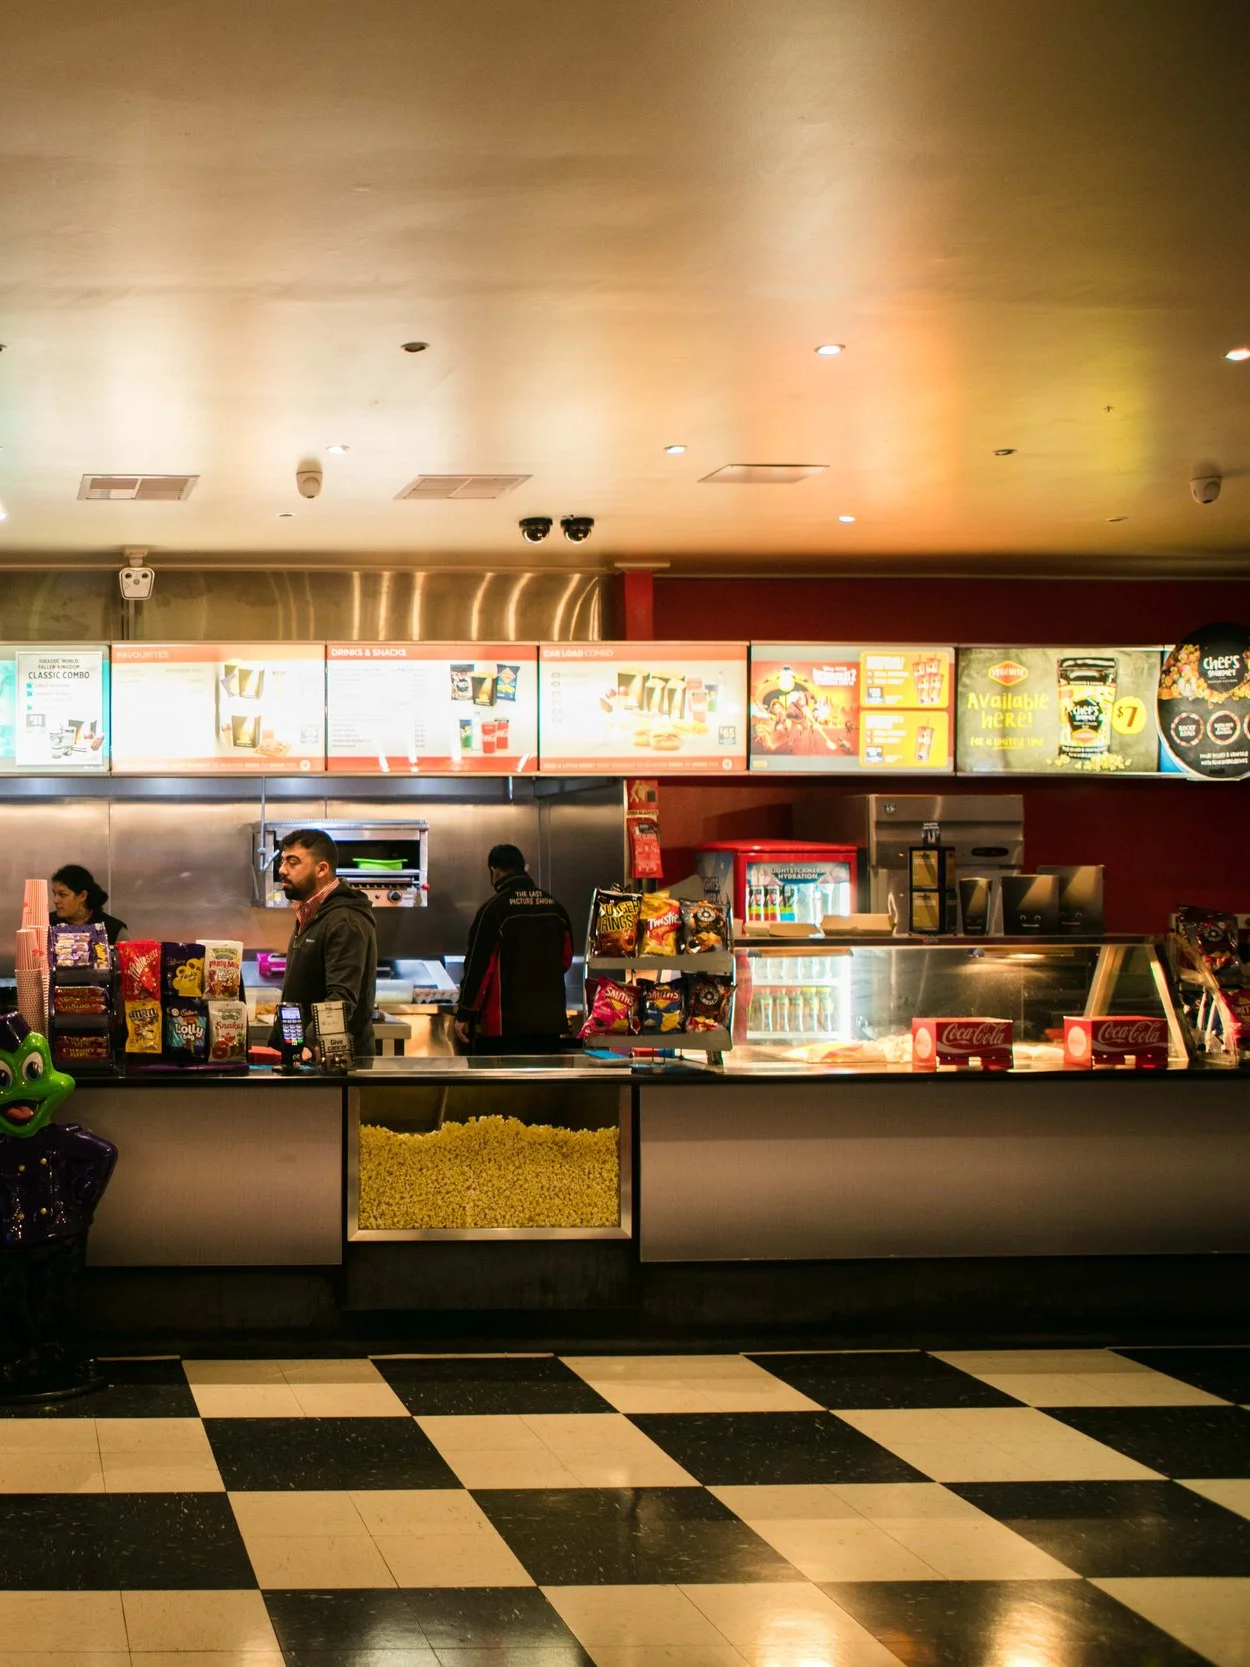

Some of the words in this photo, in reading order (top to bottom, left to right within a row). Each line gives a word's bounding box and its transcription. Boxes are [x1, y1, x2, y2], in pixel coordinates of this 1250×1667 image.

[116, 650, 169, 659] FAVOURITES
[331, 648, 363, 657] DRINKS
[364, 648, 372, 657] &
[372, 648, 407, 657] SNACKS
[543, 649, 560, 658] CAR
[561, 649, 584, 658] LOAD
[28, 671, 60, 679] CLASSIC
[62, 671, 90, 679] COMBO
[967, 691, 1050, 710] Available
[1116, 704, 1138, 728] $7
[515, 890, 528, 898] THE
[529, 890, 543, 898] LAST
[509, 897, 533, 905] PICTURE
[601, 914, 634, 934] RINGS
[647, 911, 681, 931] Twistie
[175, 1022, 204, 1038] Lolly
[215, 1021, 244, 1031] Snakes
[1097, 1021, 1164, 1043] Coca-Cola
[942, 1022, 1008, 1046] Coca-Cola
